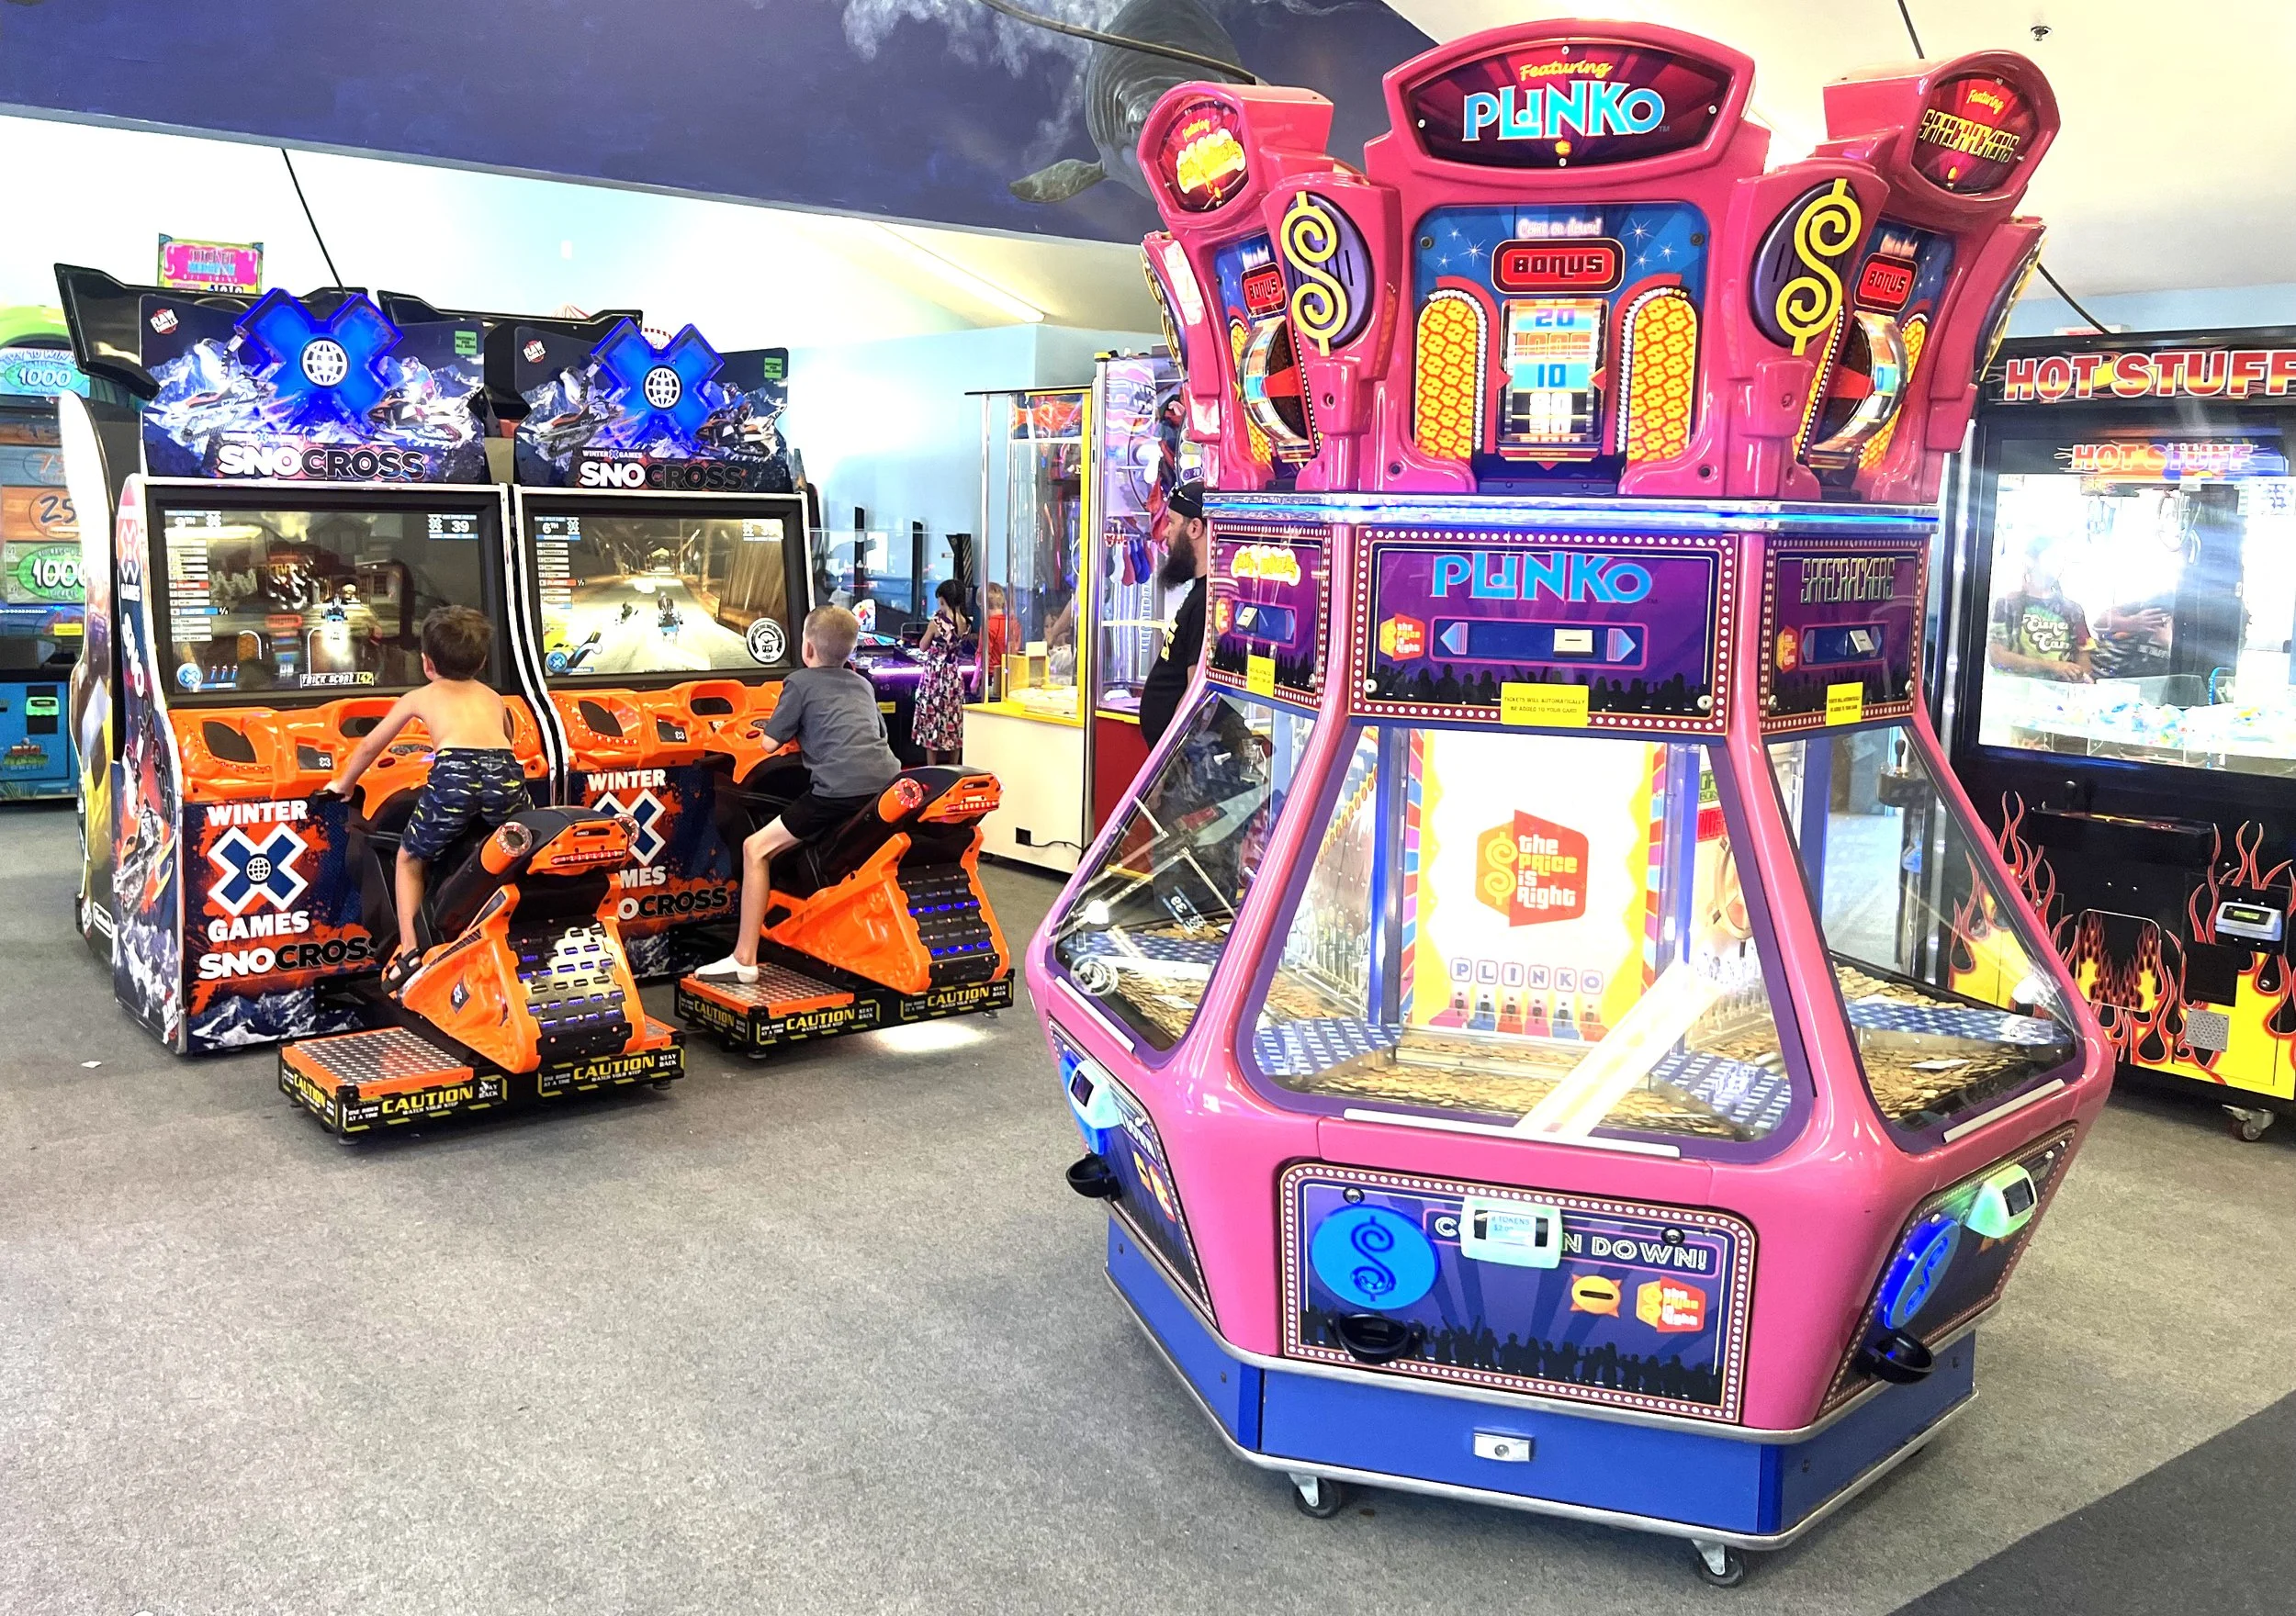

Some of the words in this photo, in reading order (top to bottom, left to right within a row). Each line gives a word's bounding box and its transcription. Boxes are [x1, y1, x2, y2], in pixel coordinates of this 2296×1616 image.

[1519, 60, 1614, 81] Featuring
[1461, 80, 1666, 141] PLINKO
[1919, 108, 2020, 163] SAFECRACKERS
[1513, 255, 1604, 278] BONUS
[1247, 278, 1278, 301] BONUS
[1867, 270, 1907, 296] BONUS
[1535, 308, 1576, 327] 20
[17, 366, 73, 388] 1000
[1537, 364, 1566, 388] 10
[2004, 355, 2103, 401] HOT
[2110, 350, 2296, 398] STUFF
[219, 444, 426, 479] SNOCROSS
[619, 451, 643, 459] GAMES
[2072, 443, 2140, 471] HOT
[580, 461, 744, 489] SNOCROSS
[451, 520, 470, 533] 39
[1430, 551, 1653, 604] PLINKO
[1801, 557, 1896, 603] SAFECRACKERS
[587, 769, 667, 791] WINTER
[207, 800, 309, 826] WINTER
[1518, 834, 1559, 855] the
[620, 866, 667, 889] MES
[1517, 870, 1537, 887] is
[618, 886, 728, 920] OCROSS
[1517, 885, 1576, 910] Right
[208, 911, 310, 942] GAMES
[927, 986, 989, 1007] CAUTION
[694, 1000, 735, 1027] CAUTION
[786, 1009, 855, 1031] CAUTION
[574, 1055, 655, 1080] CAUTION
[294, 1073, 326, 1107] CAUTION
[382, 1086, 474, 1114] CAUTION
[1498, 1216, 1530, 1225] TOKENS
[1562, 1233, 1582, 1253] N
[1592, 1237, 1707, 1270] DOWN!
